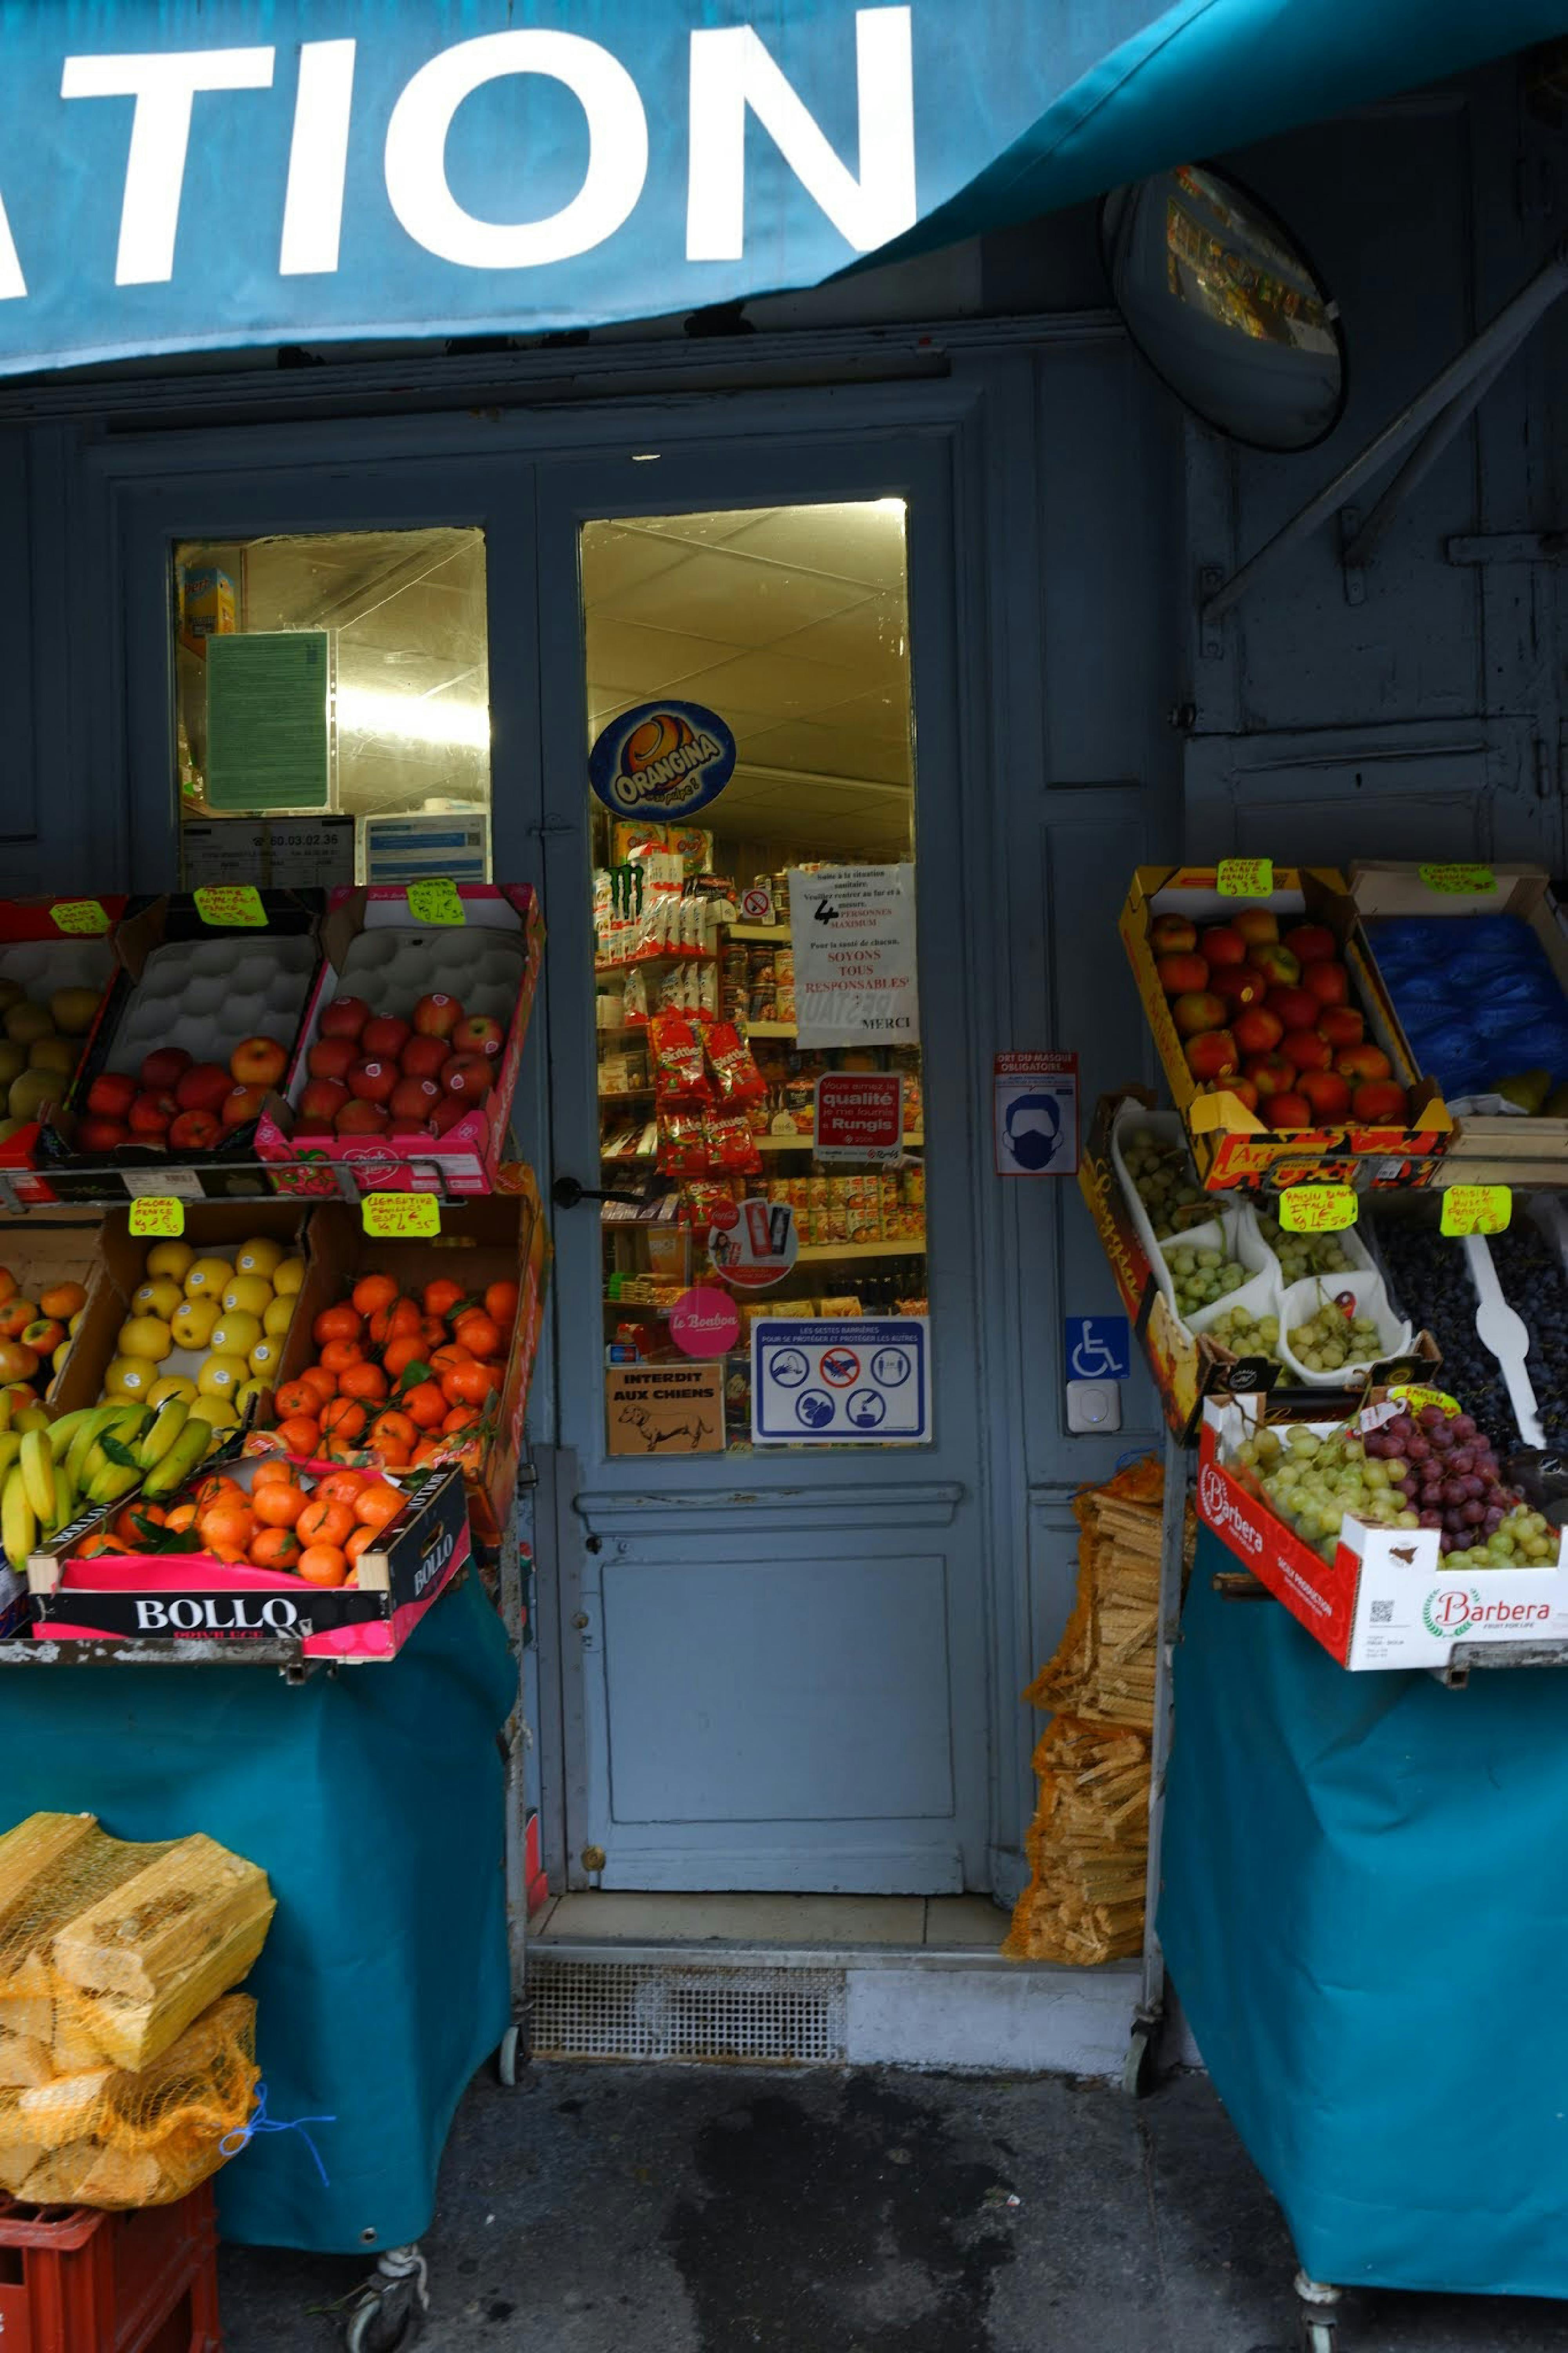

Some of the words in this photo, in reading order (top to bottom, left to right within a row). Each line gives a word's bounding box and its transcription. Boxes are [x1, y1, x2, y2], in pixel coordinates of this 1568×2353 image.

[0, 5, 918, 300] TION
[615, 734, 720, 805] ORANGINA
[814, 899, 839, 925] 4
[840, 908, 892, 918] PERSONNES
[831, 919, 877, 929] MAXIMUM
[828, 950, 881, 962] SOYONS
[838, 965, 874, 976] TOUS
[863, 1017, 910, 1030] MERCI
[824, 1081, 849, 1090] Vous
[832, 1117, 893, 1132] Rungis
[687, 1312, 738, 1328] Bonbon
[792, 1334, 829, 1343] PROTÉGER
[624, 1372, 702, 1384] INTERDIT
[614, 1390, 648, 1401] AUX
[653, 1388, 714, 1400] CHIENS
[1207, 1470, 1263, 1553] Barbera
[414, 1534, 454, 1596] BOLLO
[134, 1598, 298, 1630] BOLLO
[1435, 1591, 1550, 1626] Barbera
